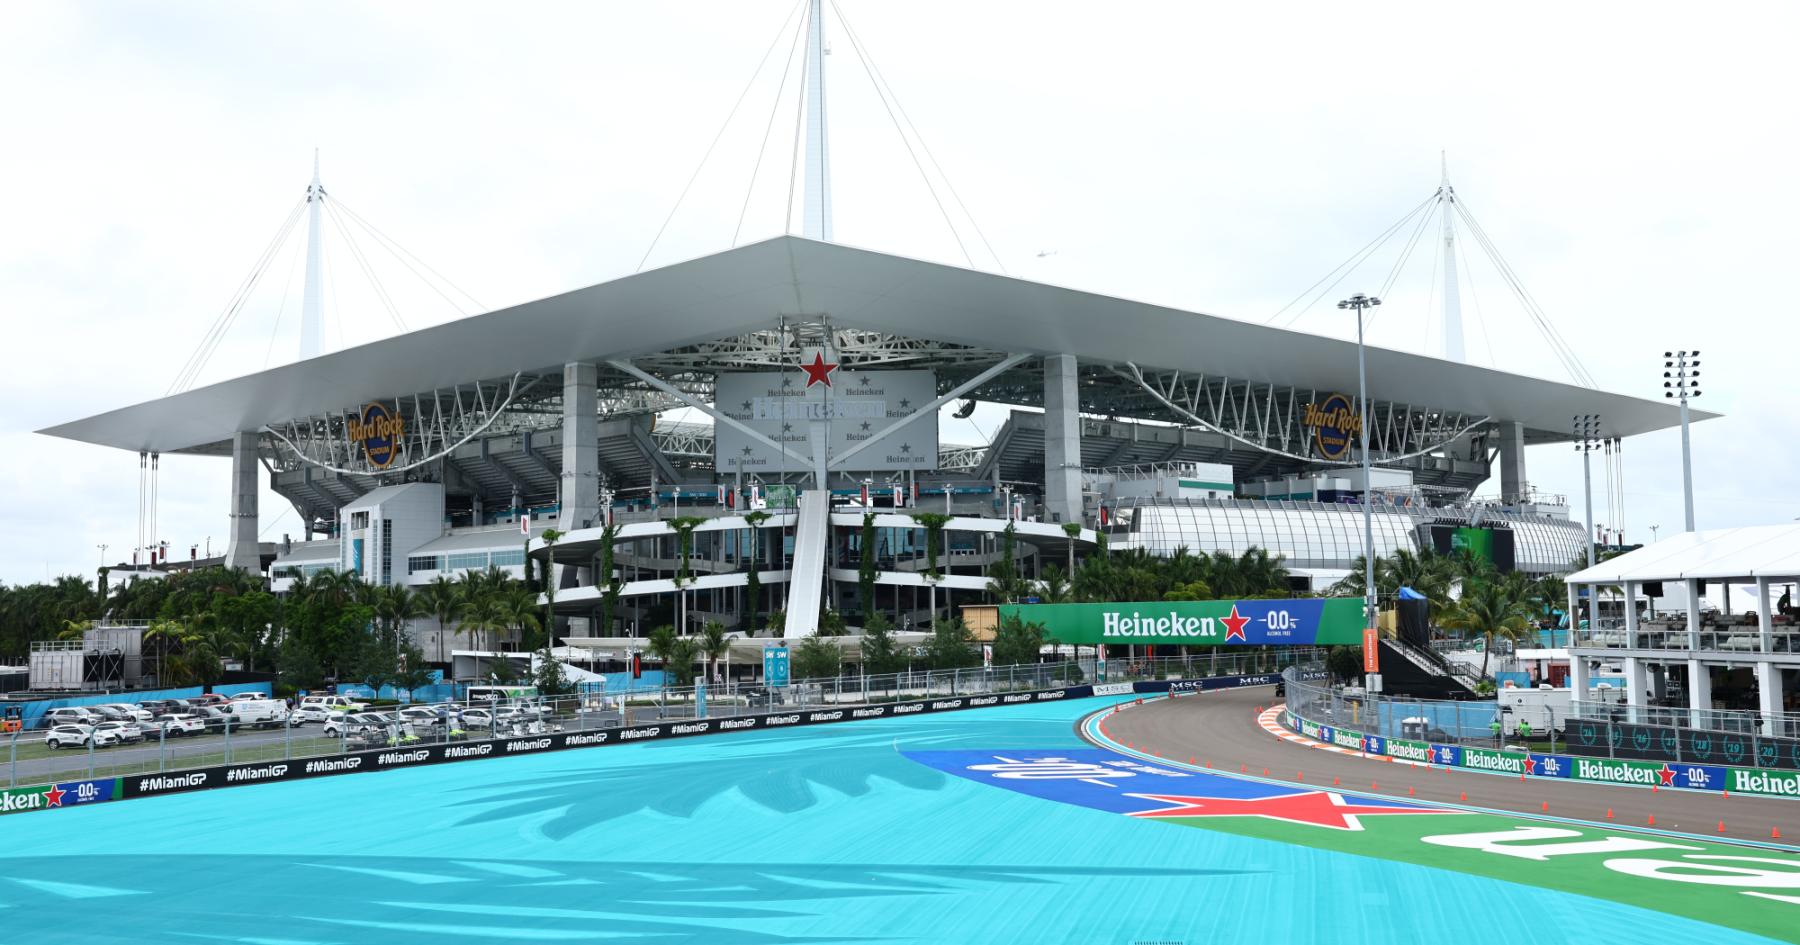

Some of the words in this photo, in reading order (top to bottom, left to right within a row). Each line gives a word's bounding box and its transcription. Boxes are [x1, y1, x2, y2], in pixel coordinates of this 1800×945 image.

[1306, 403, 1337, 426] Hard
[349, 417, 374, 441] Hard
[375, 412, 404, 441] Rock
[1102, 611, 1217, 637] Heineken
[1171, 681, 1203, 689] MSC
[1240, 676, 1269, 684] MSC
[933, 700, 961, 709] #MiamiGP
[970, 697, 998, 706] #MiamiGP
[853, 708, 884, 717] #MiamiGP
[894, 704, 924, 713] #MiamiGP
[766, 715, 800, 725] #MiamiGP
[810, 712, 842, 721] #MiamiGP
[672, 723, 709, 734] #MiamiGP
[720, 719, 755, 729] #MiamiGP
[566, 733, 607, 745] #MiamiGP
[620, 728, 659, 739] #MiamiGP
[445, 745, 492, 758] #MiamiGP
[507, 739, 551, 752] #MiamiGP
[1387, 740, 1426, 761] Heineken
[378, 750, 429, 764] #MiamiGP
[1465, 750, 1521, 772] Heineken
[306, 758, 361, 772] #MiamiGP
[227, 765, 288, 782] #MiamiGP
[1579, 760, 1655, 784] Heineken
[140, 773, 206, 791] #MiamiGP
